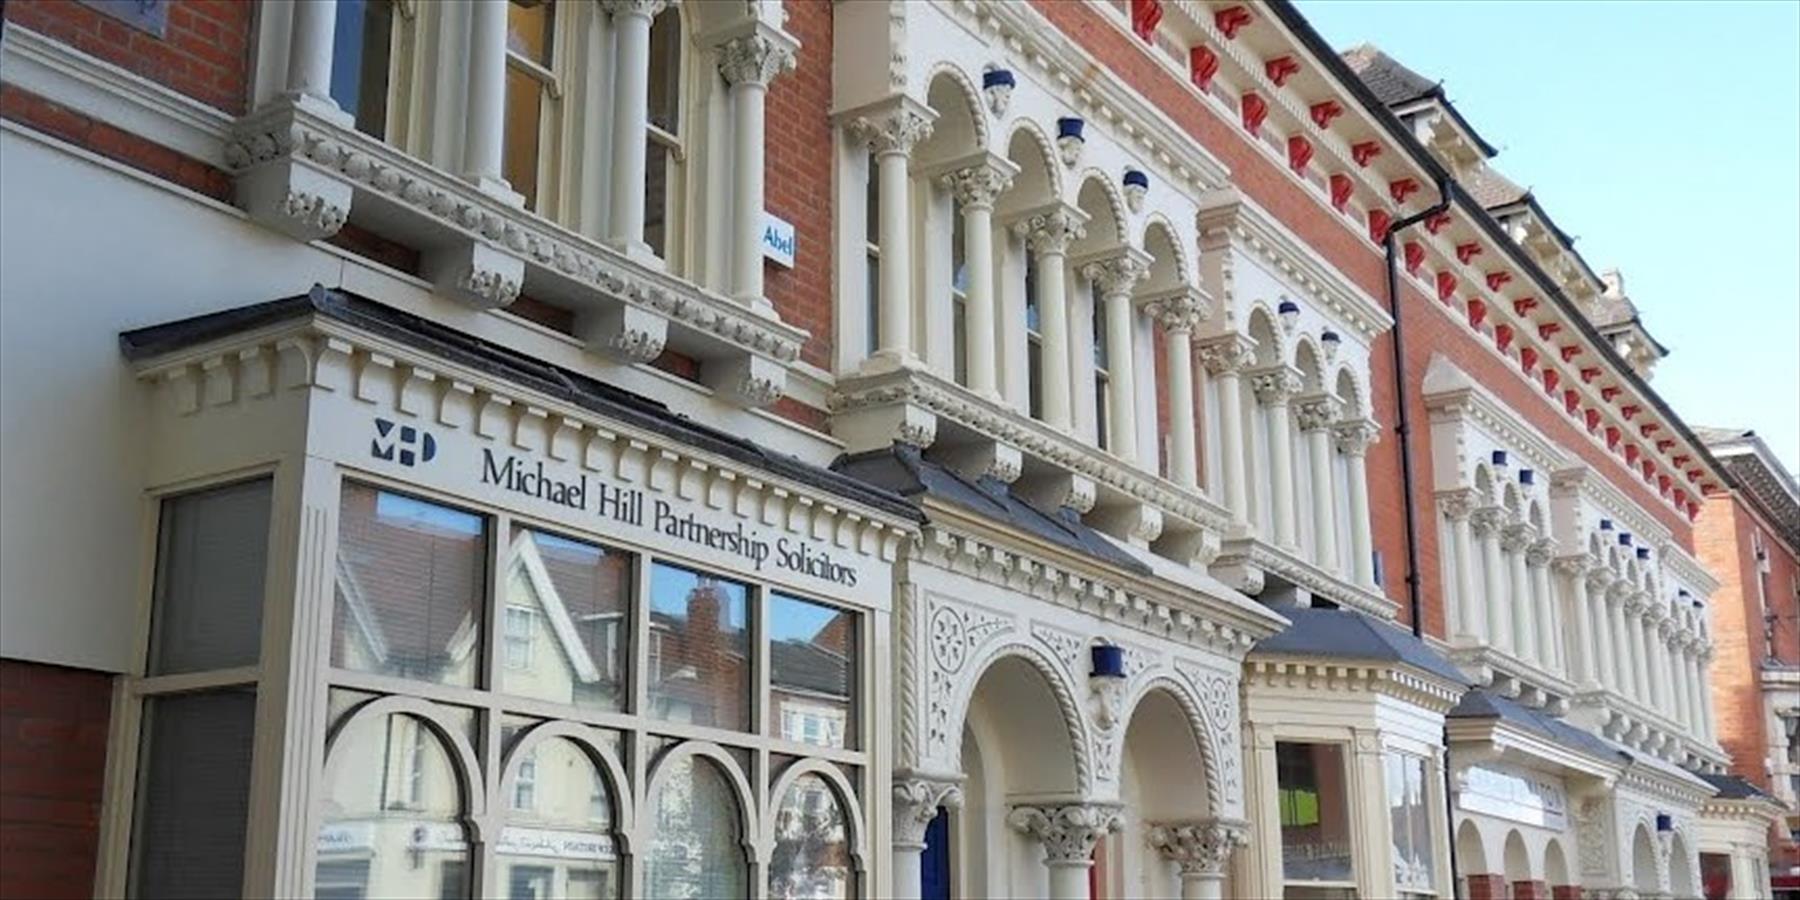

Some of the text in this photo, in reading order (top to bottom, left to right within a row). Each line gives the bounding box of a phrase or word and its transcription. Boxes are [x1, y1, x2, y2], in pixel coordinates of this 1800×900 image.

[763, 224, 793, 257] Abel
[480, 447, 858, 588] Michael Hill Partnership Solicitors
